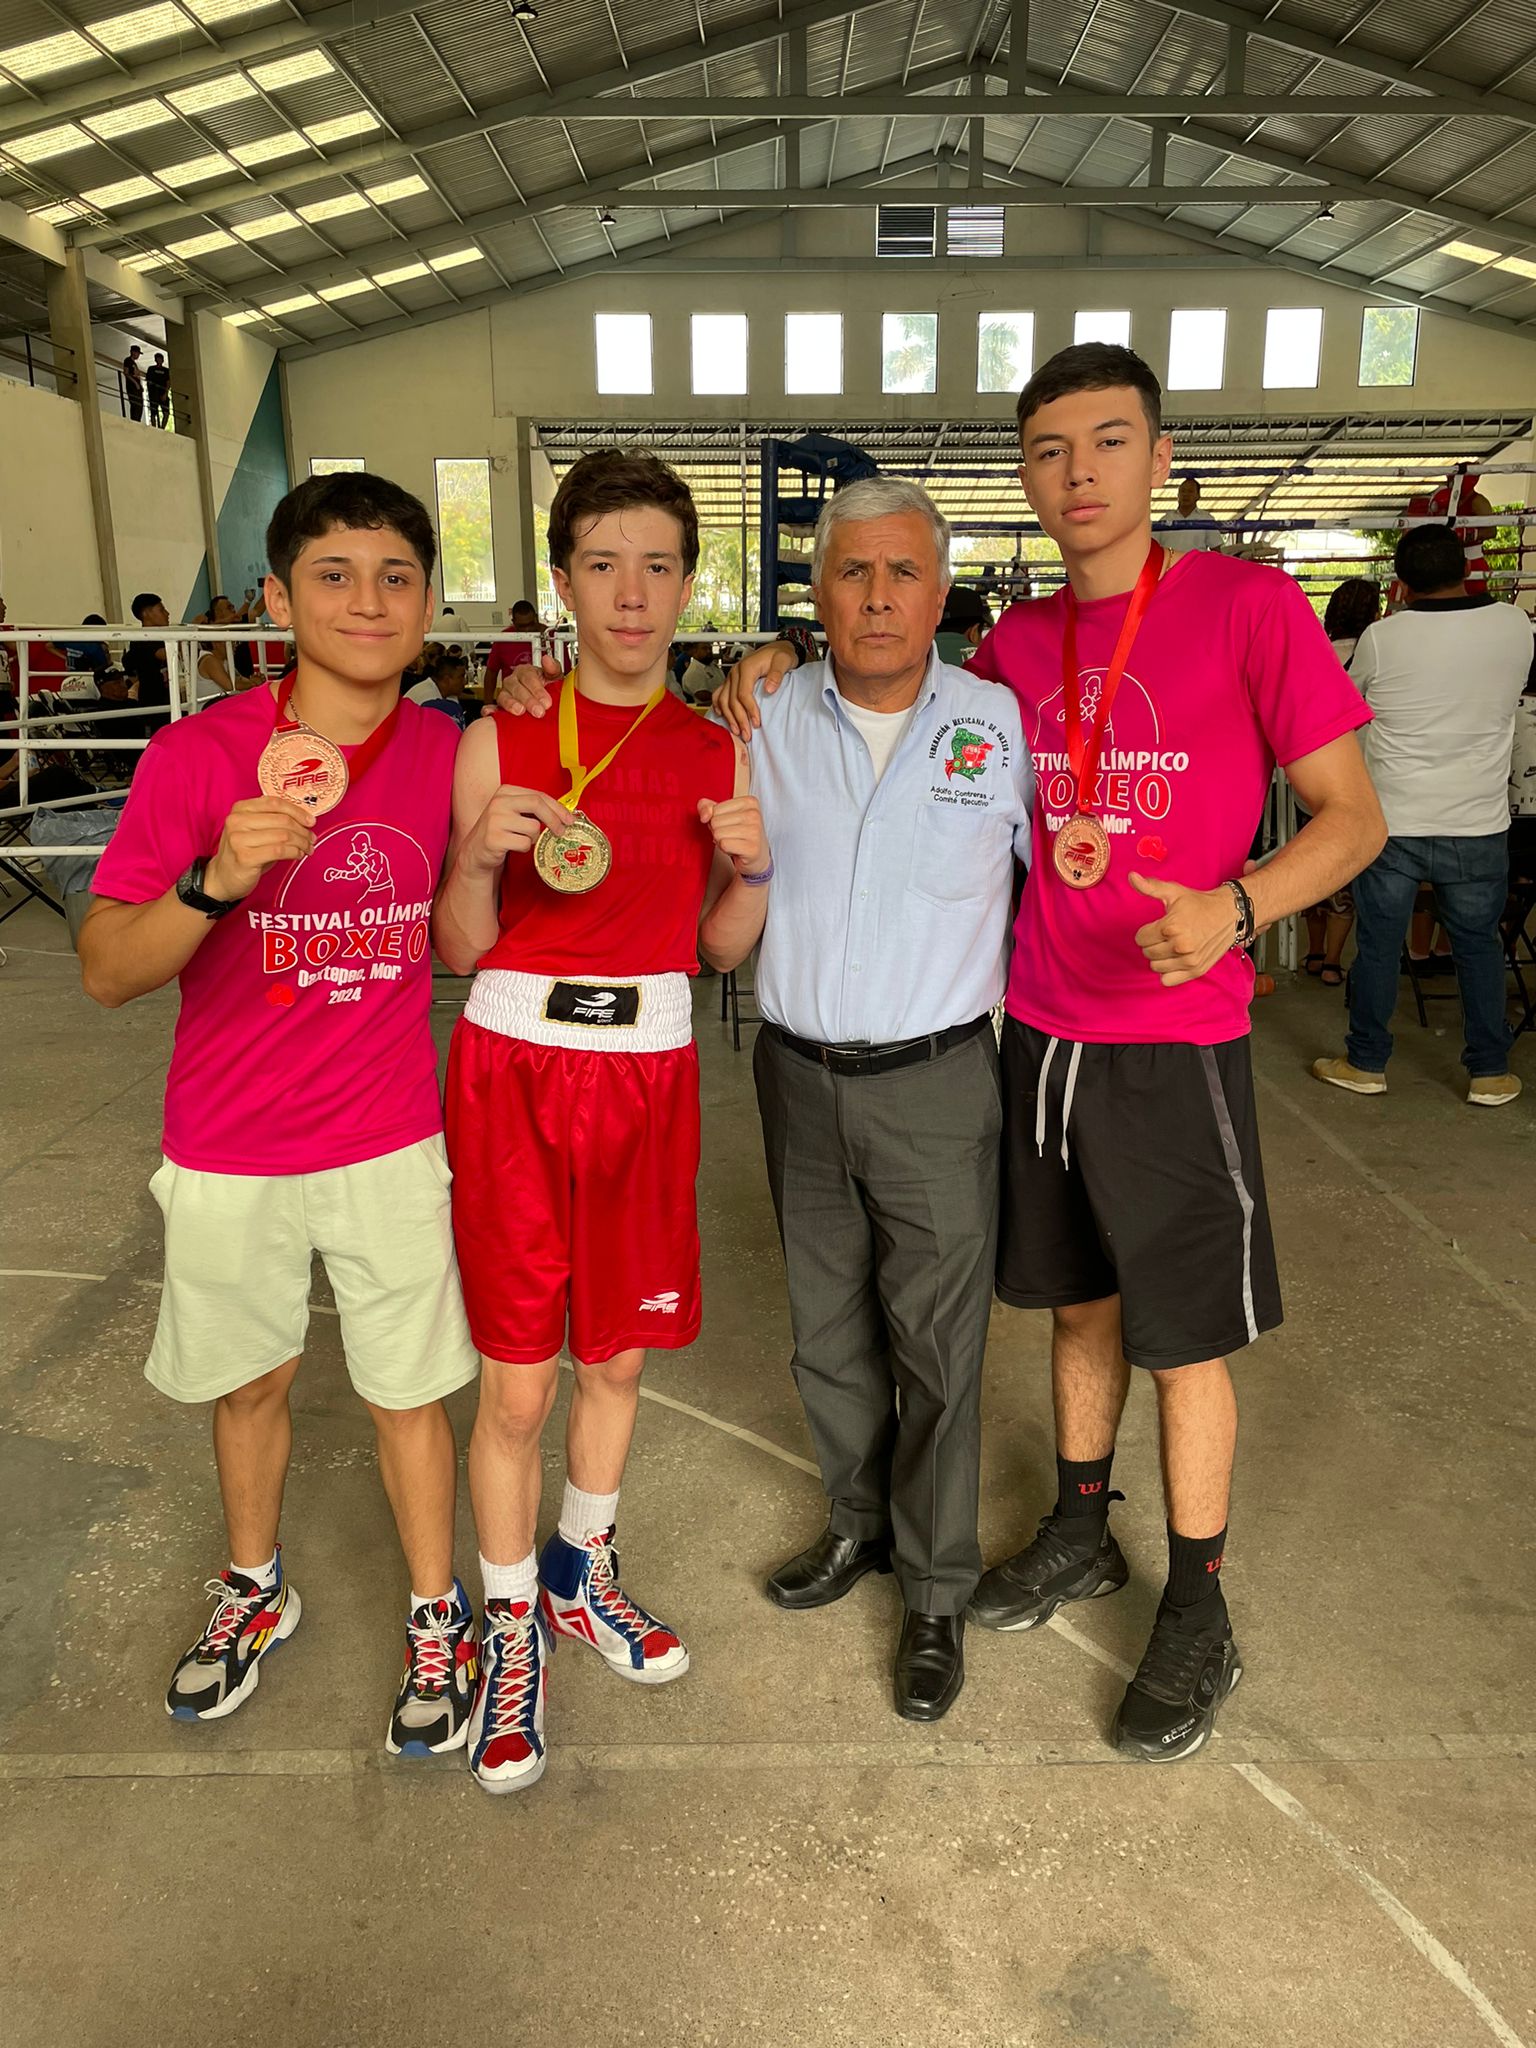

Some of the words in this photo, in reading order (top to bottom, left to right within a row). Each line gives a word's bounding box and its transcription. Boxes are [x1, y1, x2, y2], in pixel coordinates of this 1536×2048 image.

[952, 717, 985, 727] MEXICANA
[988, 723, 997, 732] DE
[996, 731, 1009, 752] BOXEO
[1031, 752, 1072, 772] STIVA
[1097, 747, 1189, 772] LÍMPICO
[283, 771, 329, 790] FIRE
[930, 786, 952, 795] Adolfo
[954, 790, 987, 799] Contreras
[933, 794, 957, 804] Comité
[961, 798, 989, 807] Ejecutivo
[1103, 813, 1136, 834] Mor.
[1064, 851, 1096, 867] FIRE
[247, 909, 354, 931] FESTIVAL
[360, 898, 433, 926] OLÍMPIC
[263, 920, 428, 974] BOXEO
[369, 962, 403, 980] Mor.
[328, 986, 362, 1005] 2024
[573, 1006, 616, 1019] FIRE
